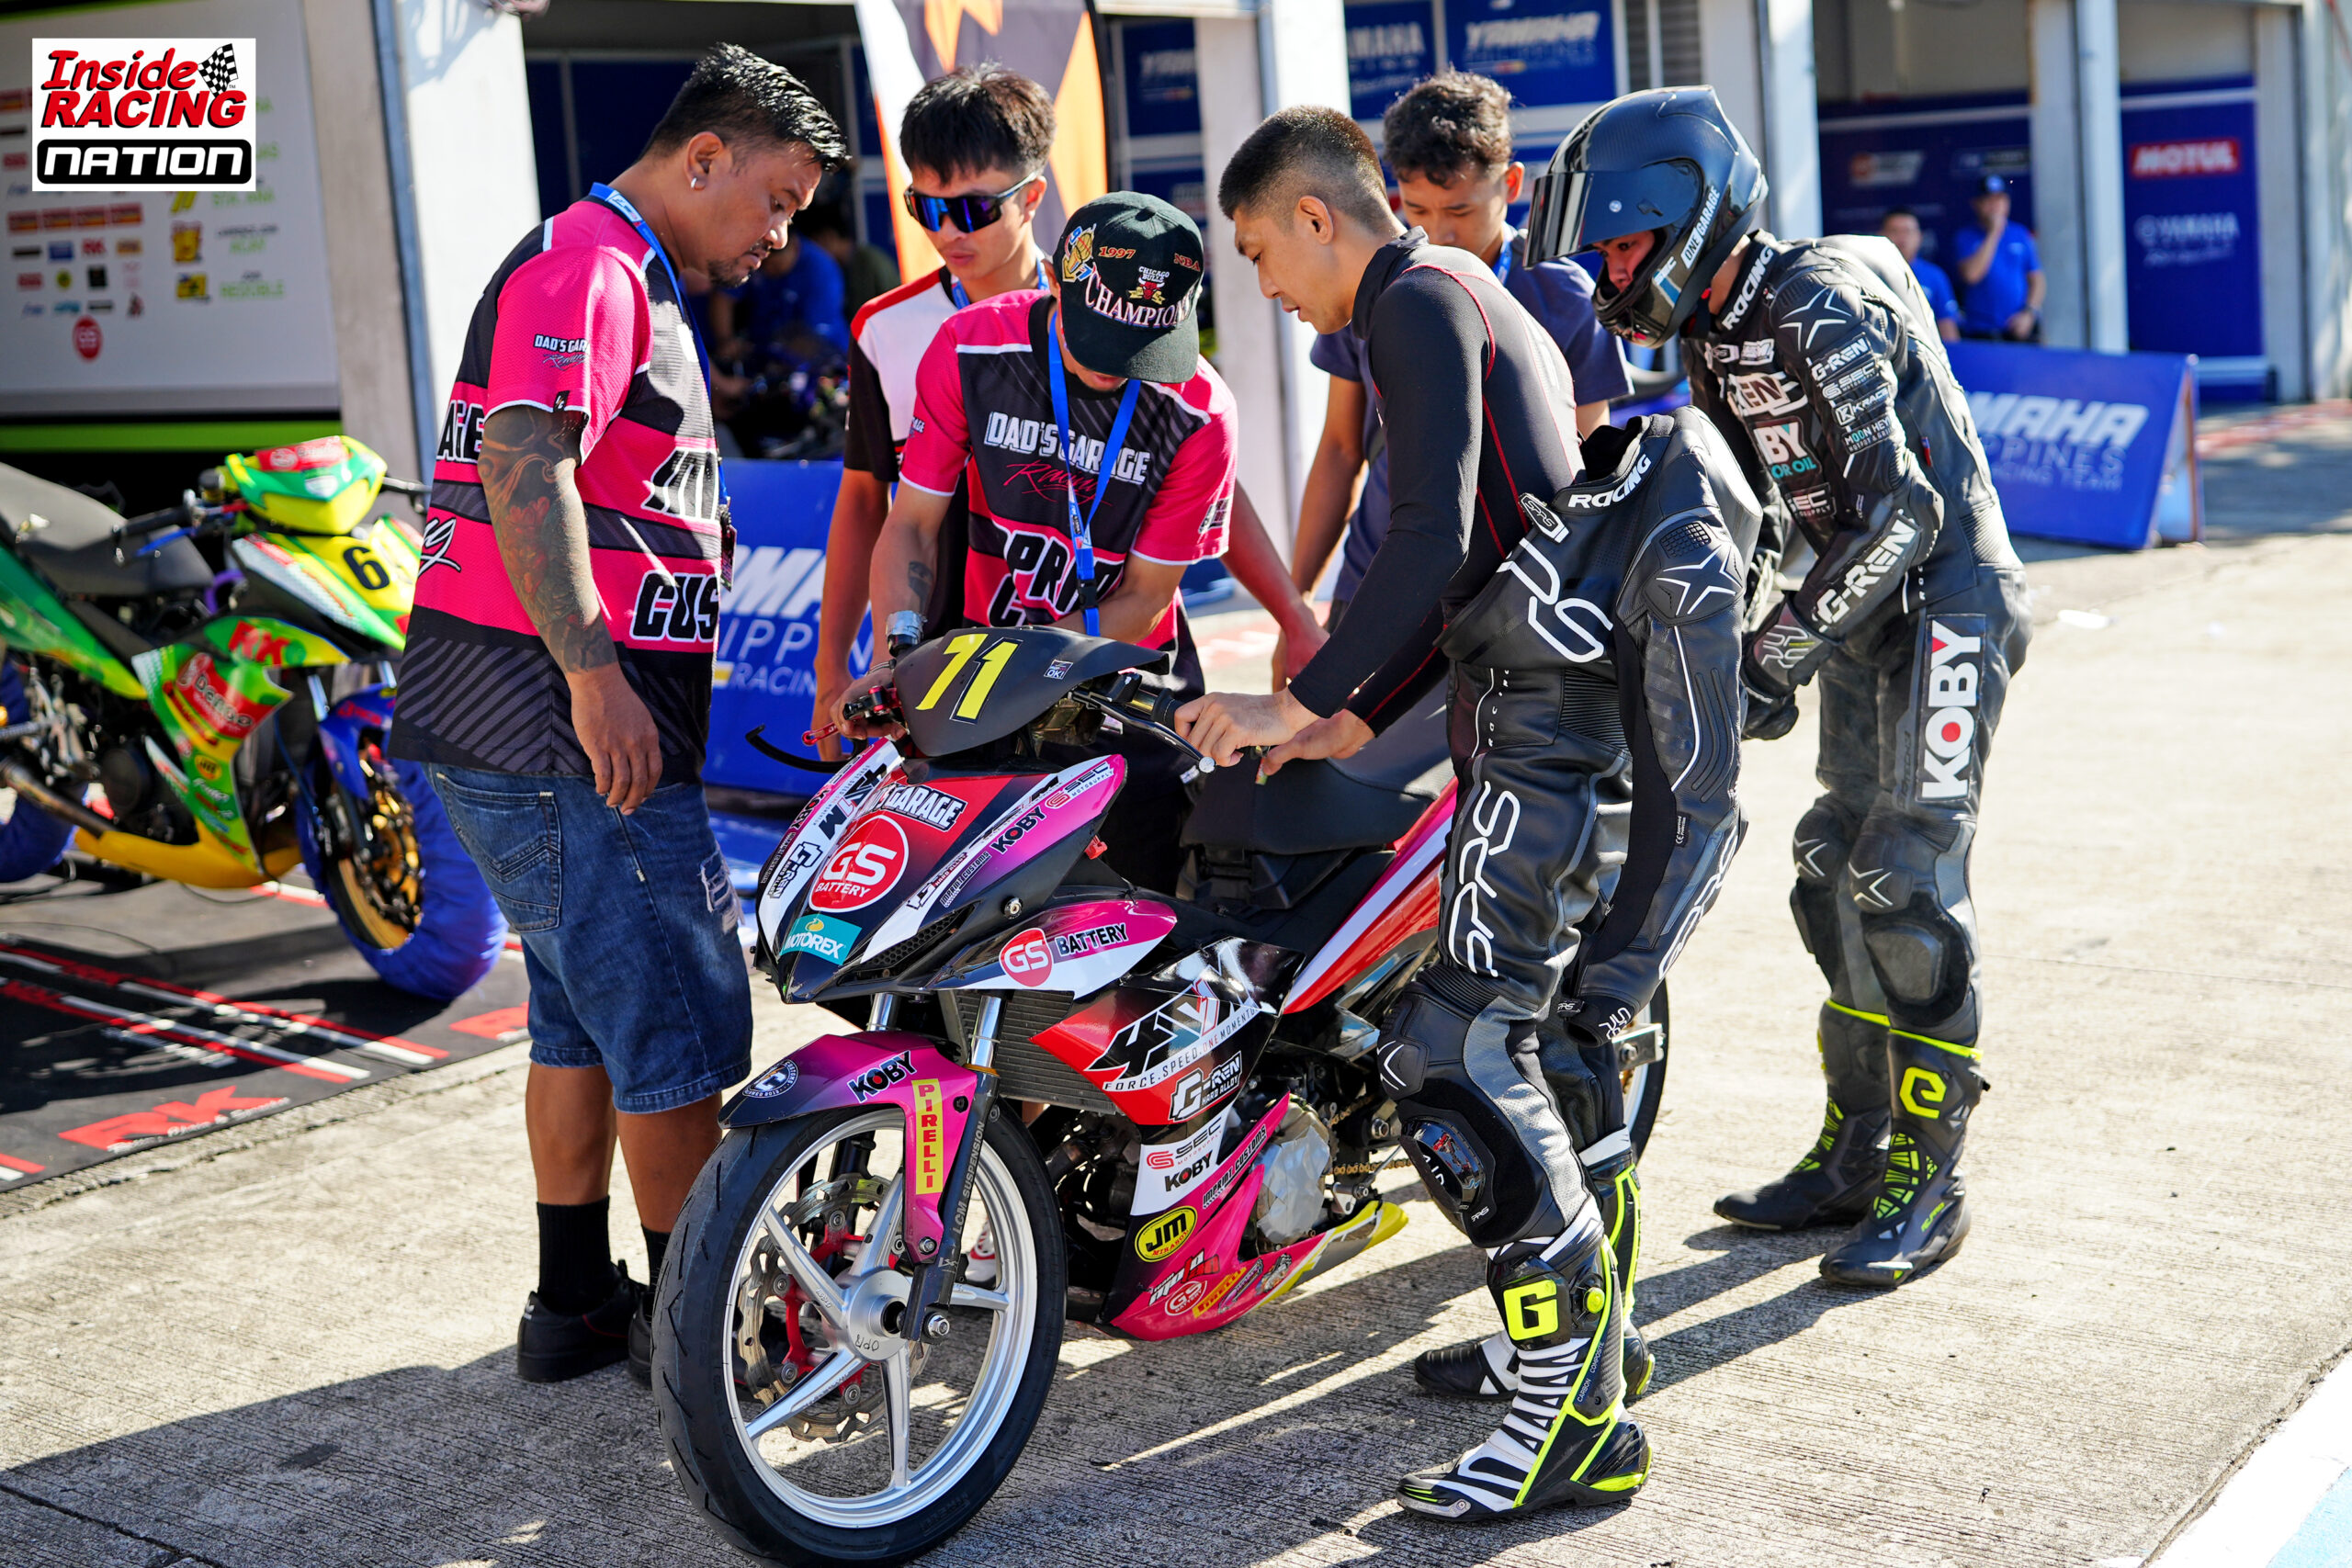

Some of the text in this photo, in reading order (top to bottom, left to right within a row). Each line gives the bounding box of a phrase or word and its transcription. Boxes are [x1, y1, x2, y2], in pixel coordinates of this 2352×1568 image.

[2133, 141, 2240, 175] MOTUL
[1099, 246, 1200, 271] 1997 NBA
[1138, 266, 1170, 277] CHICAGO
[1142, 275, 1166, 283] BULLS
[534, 334, 567, 353] DAD'S
[1811, 338, 1870, 382] G-REN
[1838, 362, 1875, 389] SEC
[984, 411, 1058, 457] DAD'S
[1567, 455, 1652, 509] RACING
[1792, 457, 1816, 474] OIL
[344, 546, 390, 591] 6
[1815, 517, 1921, 625] G-REN
[915, 633, 1020, 721] 71
[1921, 619, 1982, 799] KOBY
[1065, 762, 1109, 792] SEC
[884, 786, 967, 831] GARAGE
[991, 807, 1046, 854] KOBY
[823, 840, 898, 886] GS
[961, 852, 990, 880] CUSTOMS
[815, 882, 872, 899] BATTERY
[784, 931, 846, 960] MOTOREX
[1004, 923, 1129, 975] GS BATTERY
[847, 1050, 918, 1103] KOBY
[1169, 1055, 1242, 1121] G-REN
[919, 1084, 939, 1189] PIRELLI
[1175, 1117, 1222, 1159] SEC
[953, 1122, 985, 1235] LCM SUSPENSION
[1164, 1149, 1214, 1192] KOBY
[1203, 1125, 1267, 1205] IMPRINT CUSTOMS
[1145, 1213, 1188, 1253] JM
[1172, 1281, 1204, 1305] GS
[1504, 1280, 1560, 1341] G
[1577, 1340, 1606, 1404] CARBON COMPOSITE
